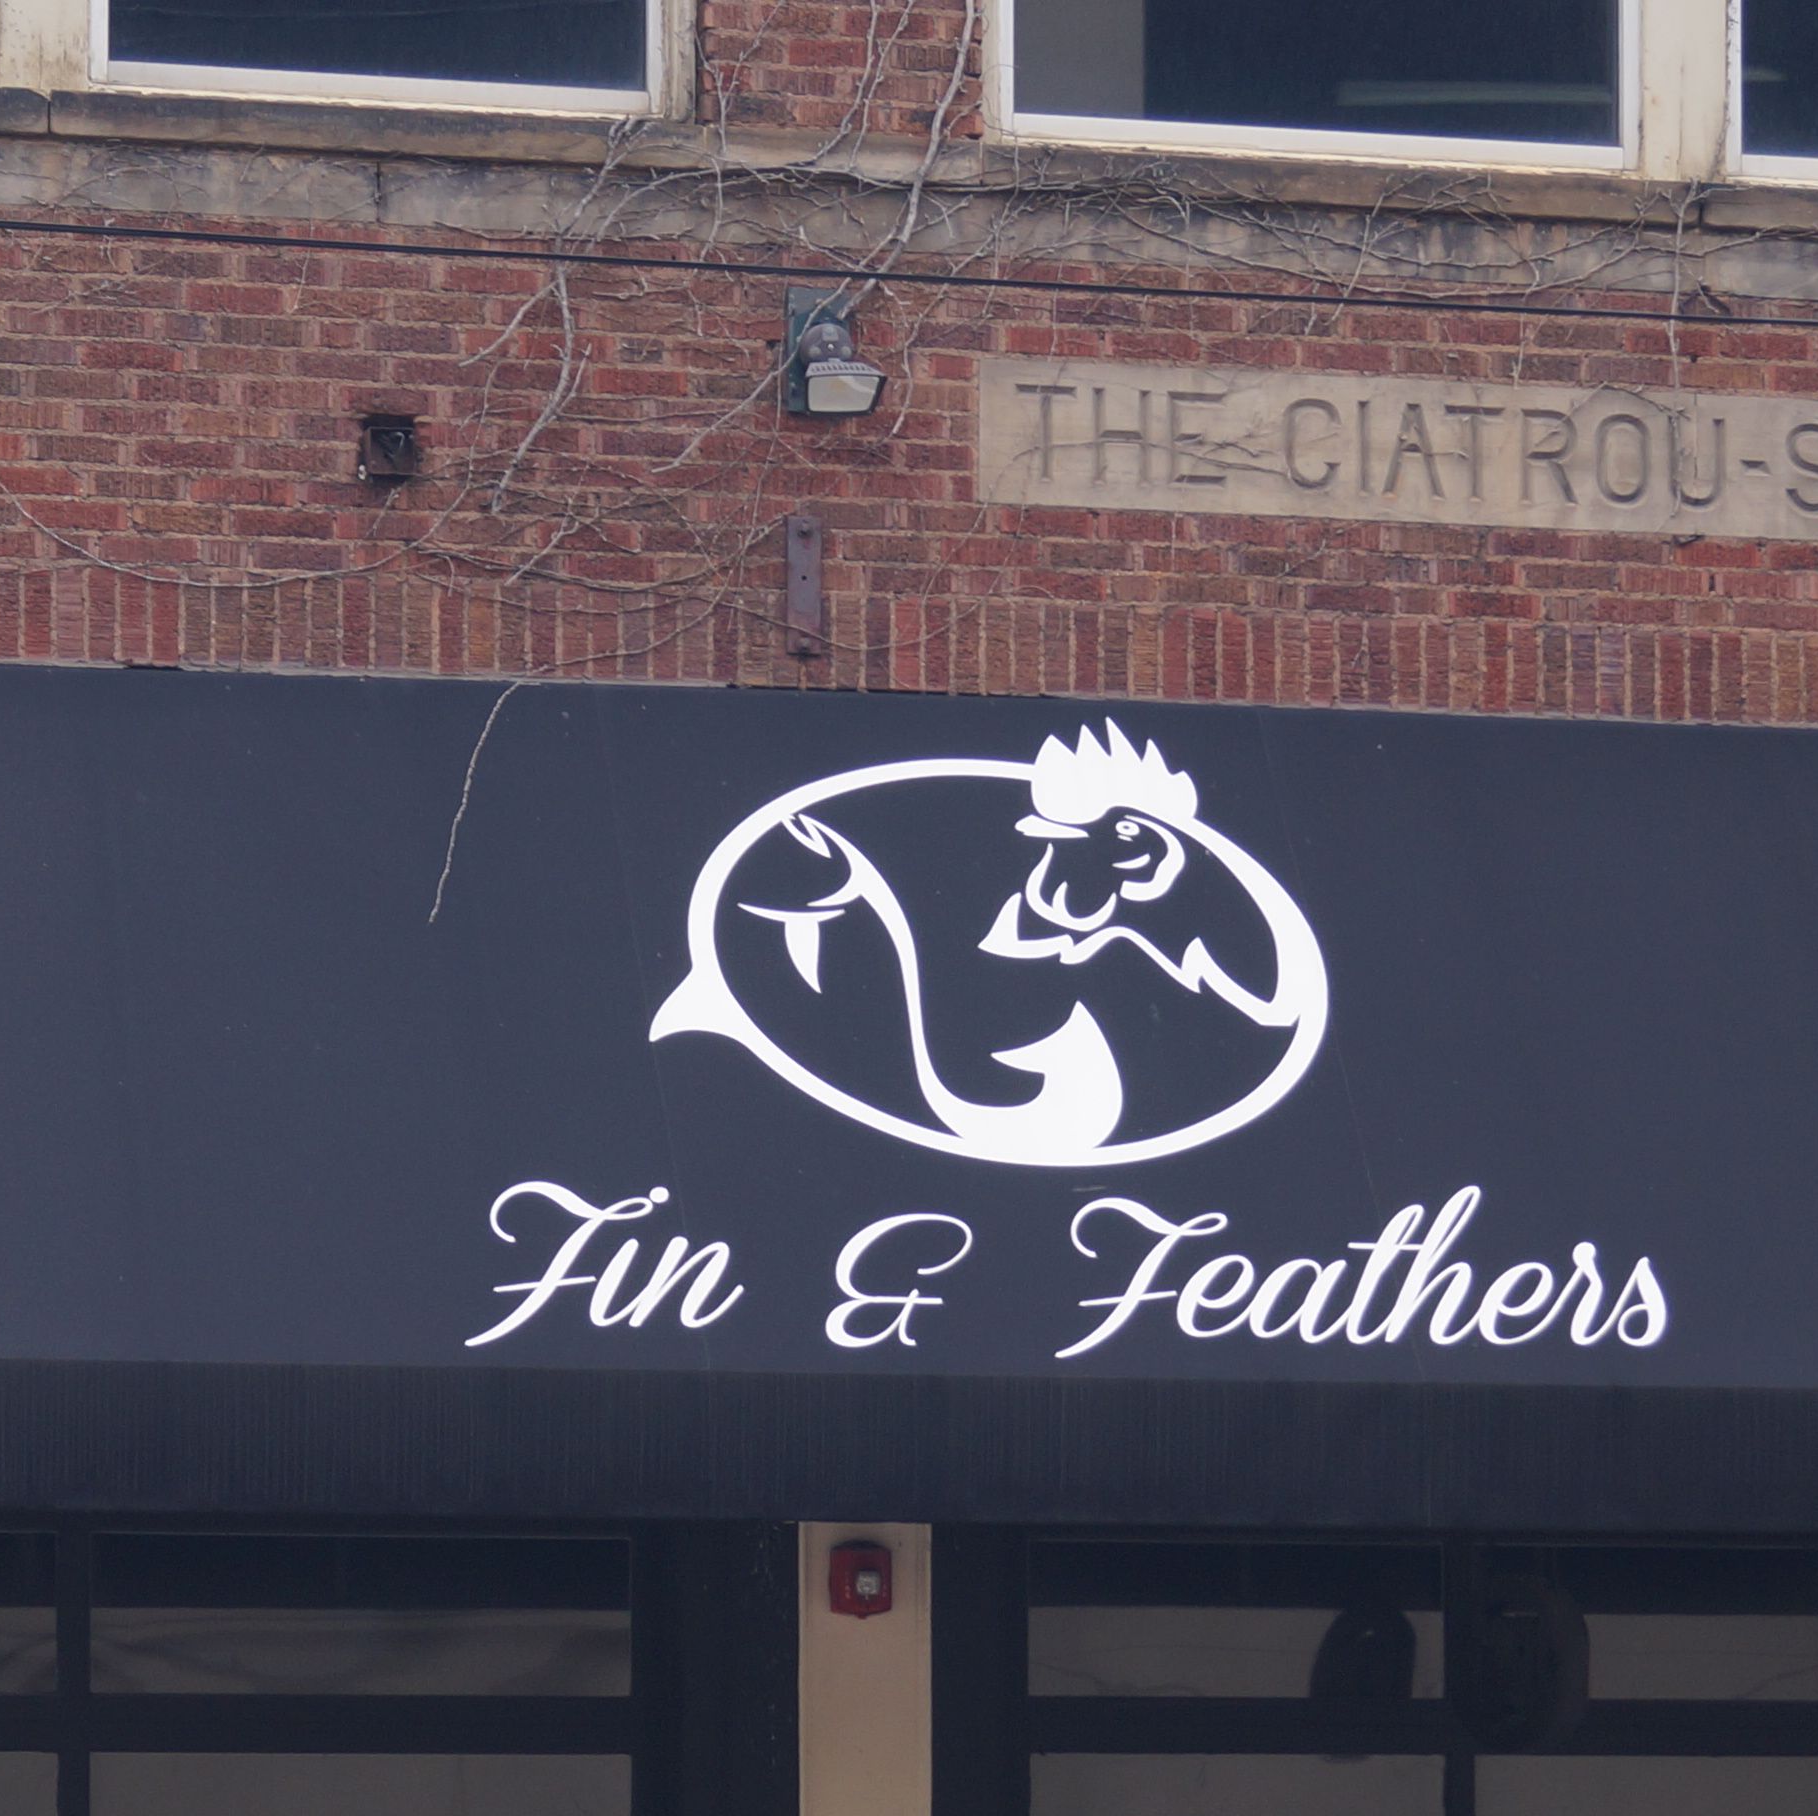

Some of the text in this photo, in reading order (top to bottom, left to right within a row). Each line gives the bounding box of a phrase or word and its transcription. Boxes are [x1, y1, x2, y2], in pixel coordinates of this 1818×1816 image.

[1014, 383, 1228, 488] THE
[464, 1180, 1667, 1359] Fin & Feathers
